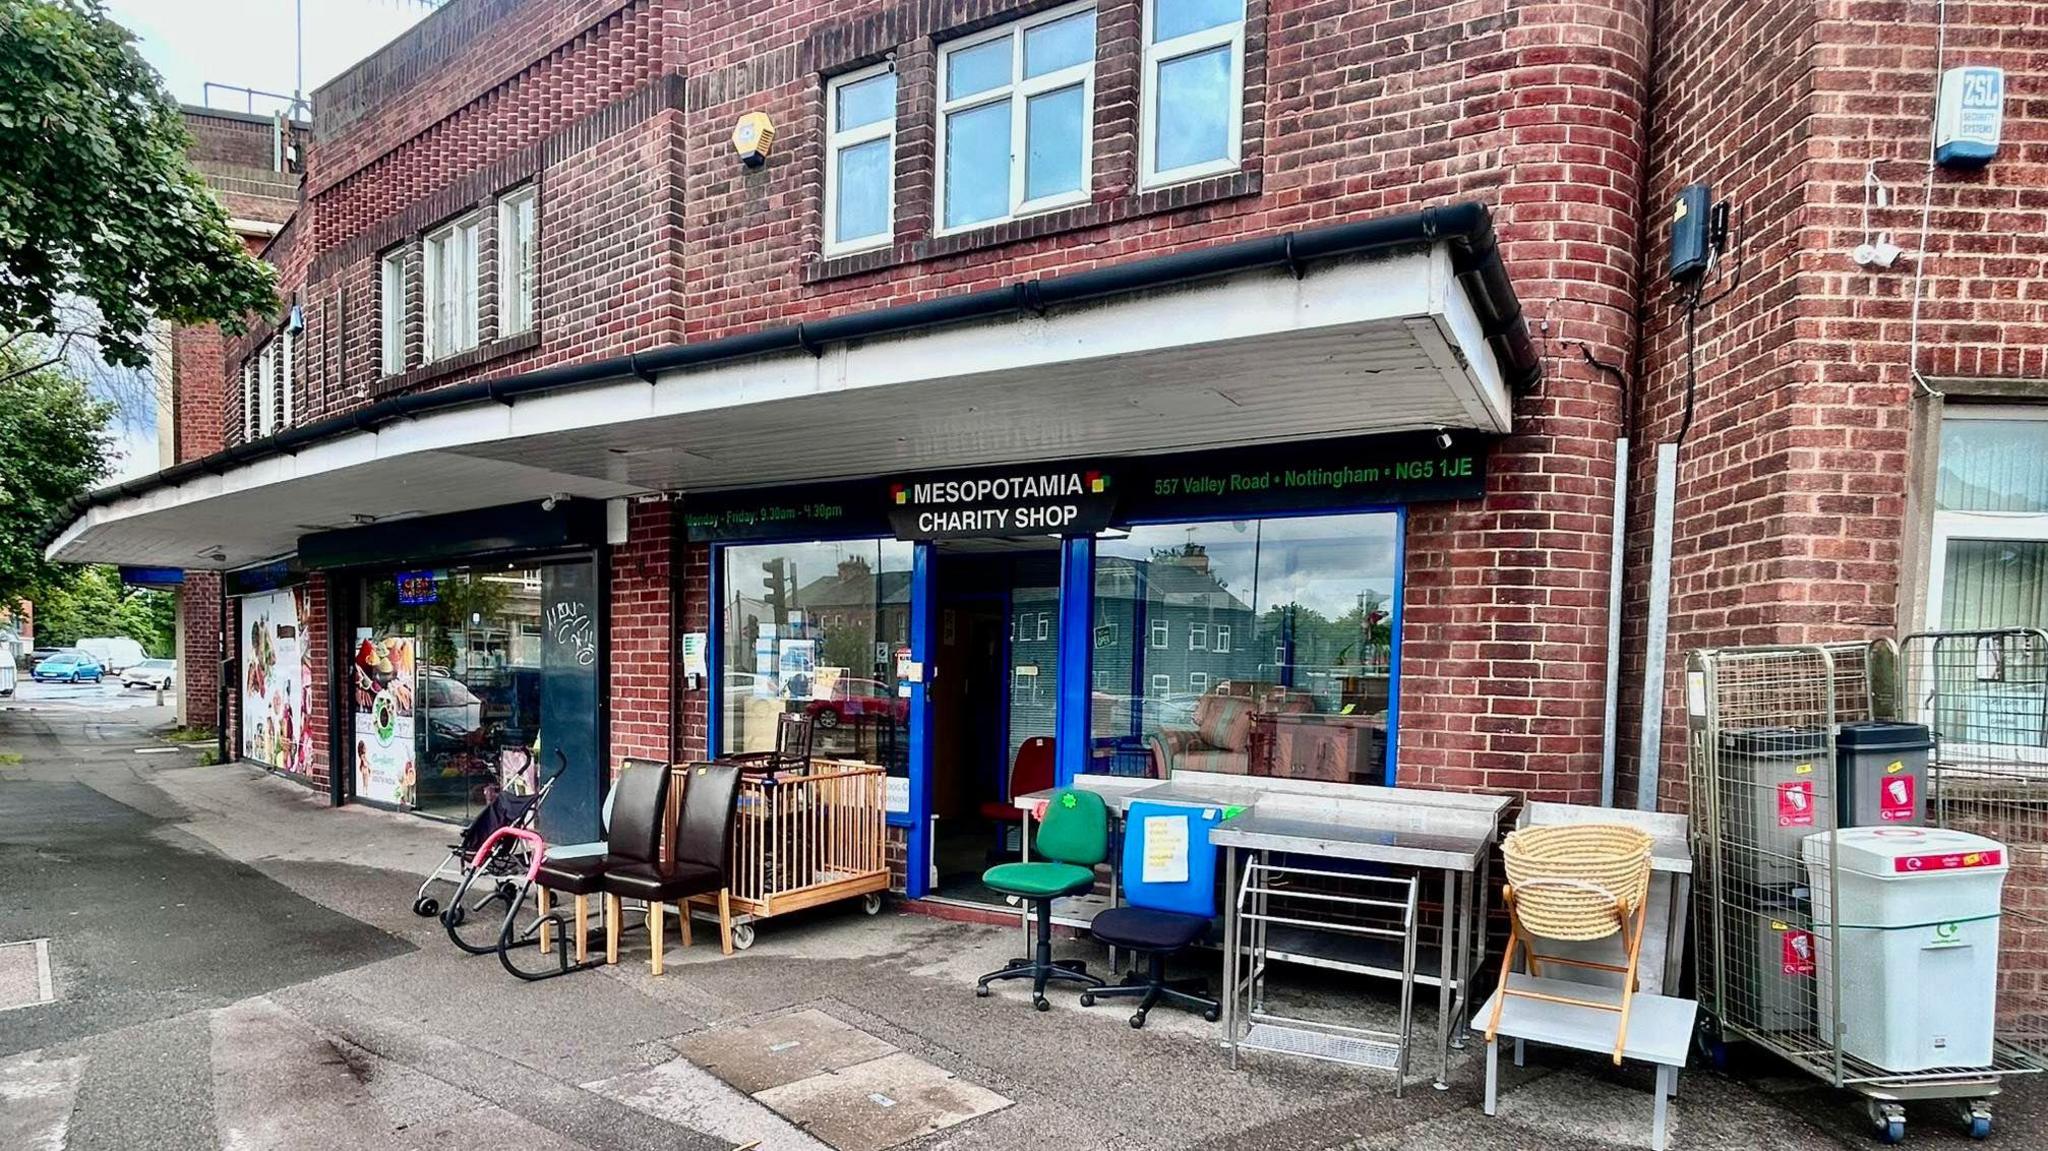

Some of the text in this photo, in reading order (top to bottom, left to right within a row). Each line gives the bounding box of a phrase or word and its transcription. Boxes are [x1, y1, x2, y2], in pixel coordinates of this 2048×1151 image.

[1963, 74, 1998, 106] ZSL
[1963, 112, 1995, 121] SECURITY
[1963, 124, 1993, 133] SYSTEMS
[914, 473, 1084, 504] MESOPOTAMIA
[1154, 457, 1473, 496] 557 Valley Road Nottingham NG5 1JE
[685, 513, 718, 528] Monday
[918, 505, 1078, 532] CHARITY SHOP
